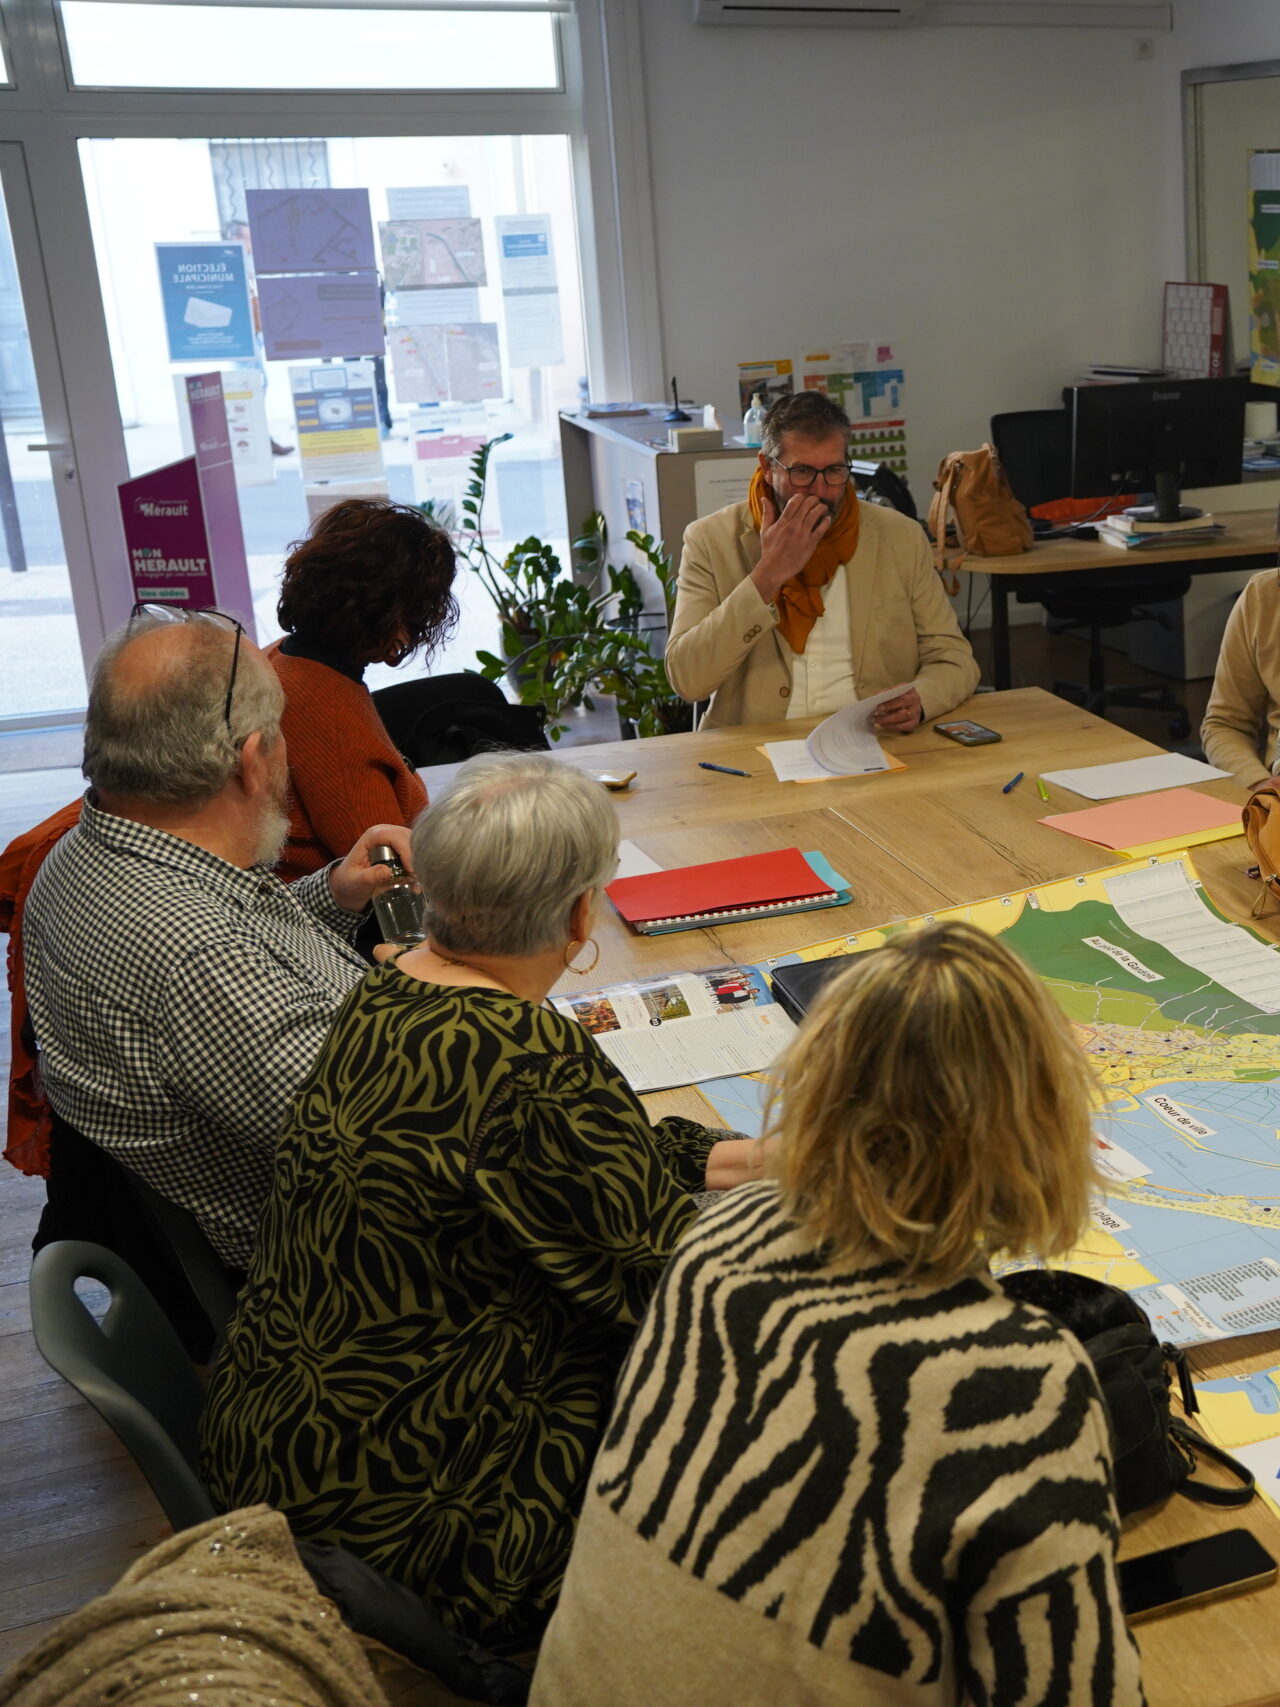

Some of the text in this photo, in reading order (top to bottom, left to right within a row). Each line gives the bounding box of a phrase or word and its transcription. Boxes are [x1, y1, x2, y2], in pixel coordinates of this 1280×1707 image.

[1154, 1097, 1208, 1135] Coeur de ville
[1095, 1211, 1120, 1228] plage
